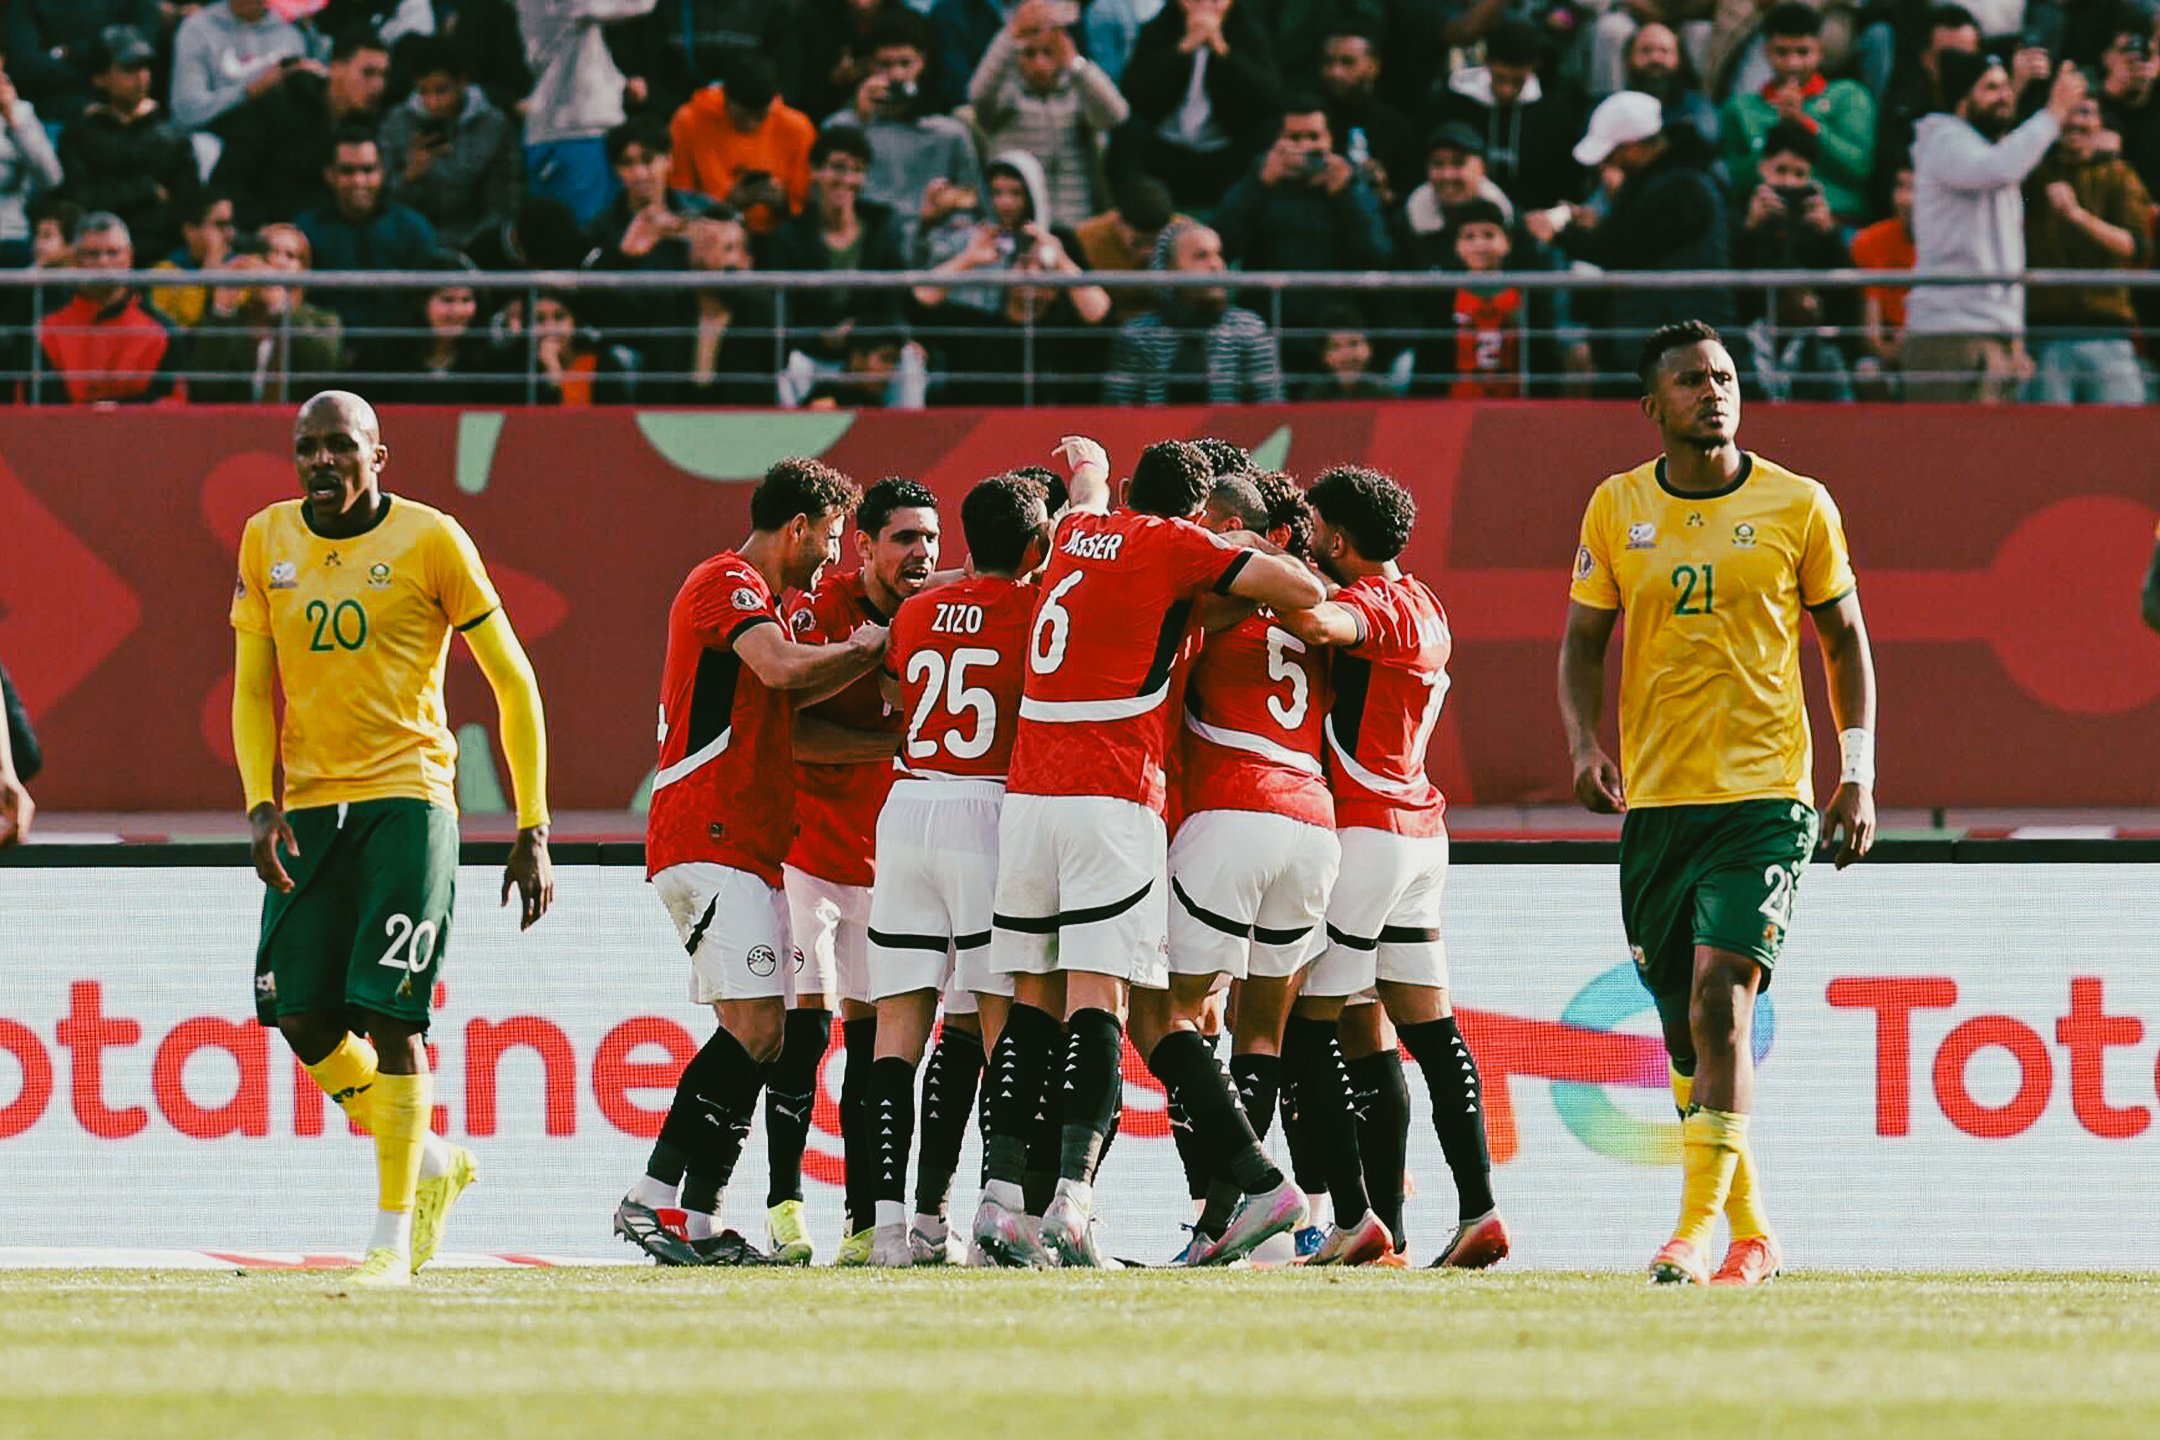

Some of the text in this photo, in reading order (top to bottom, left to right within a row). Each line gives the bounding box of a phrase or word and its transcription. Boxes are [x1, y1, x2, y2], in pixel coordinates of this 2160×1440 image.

[306, 599, 367, 652] 20
[931, 603, 983, 634] ZIZO
[1030, 569, 1084, 675] 6
[1671, 564, 1713, 616] 21
[906, 647, 1000, 759] 25
[1266, 625, 1309, 730] 5
[378, 913, 437, 973] 20
[1825, 976, 2160, 1140] Tot
